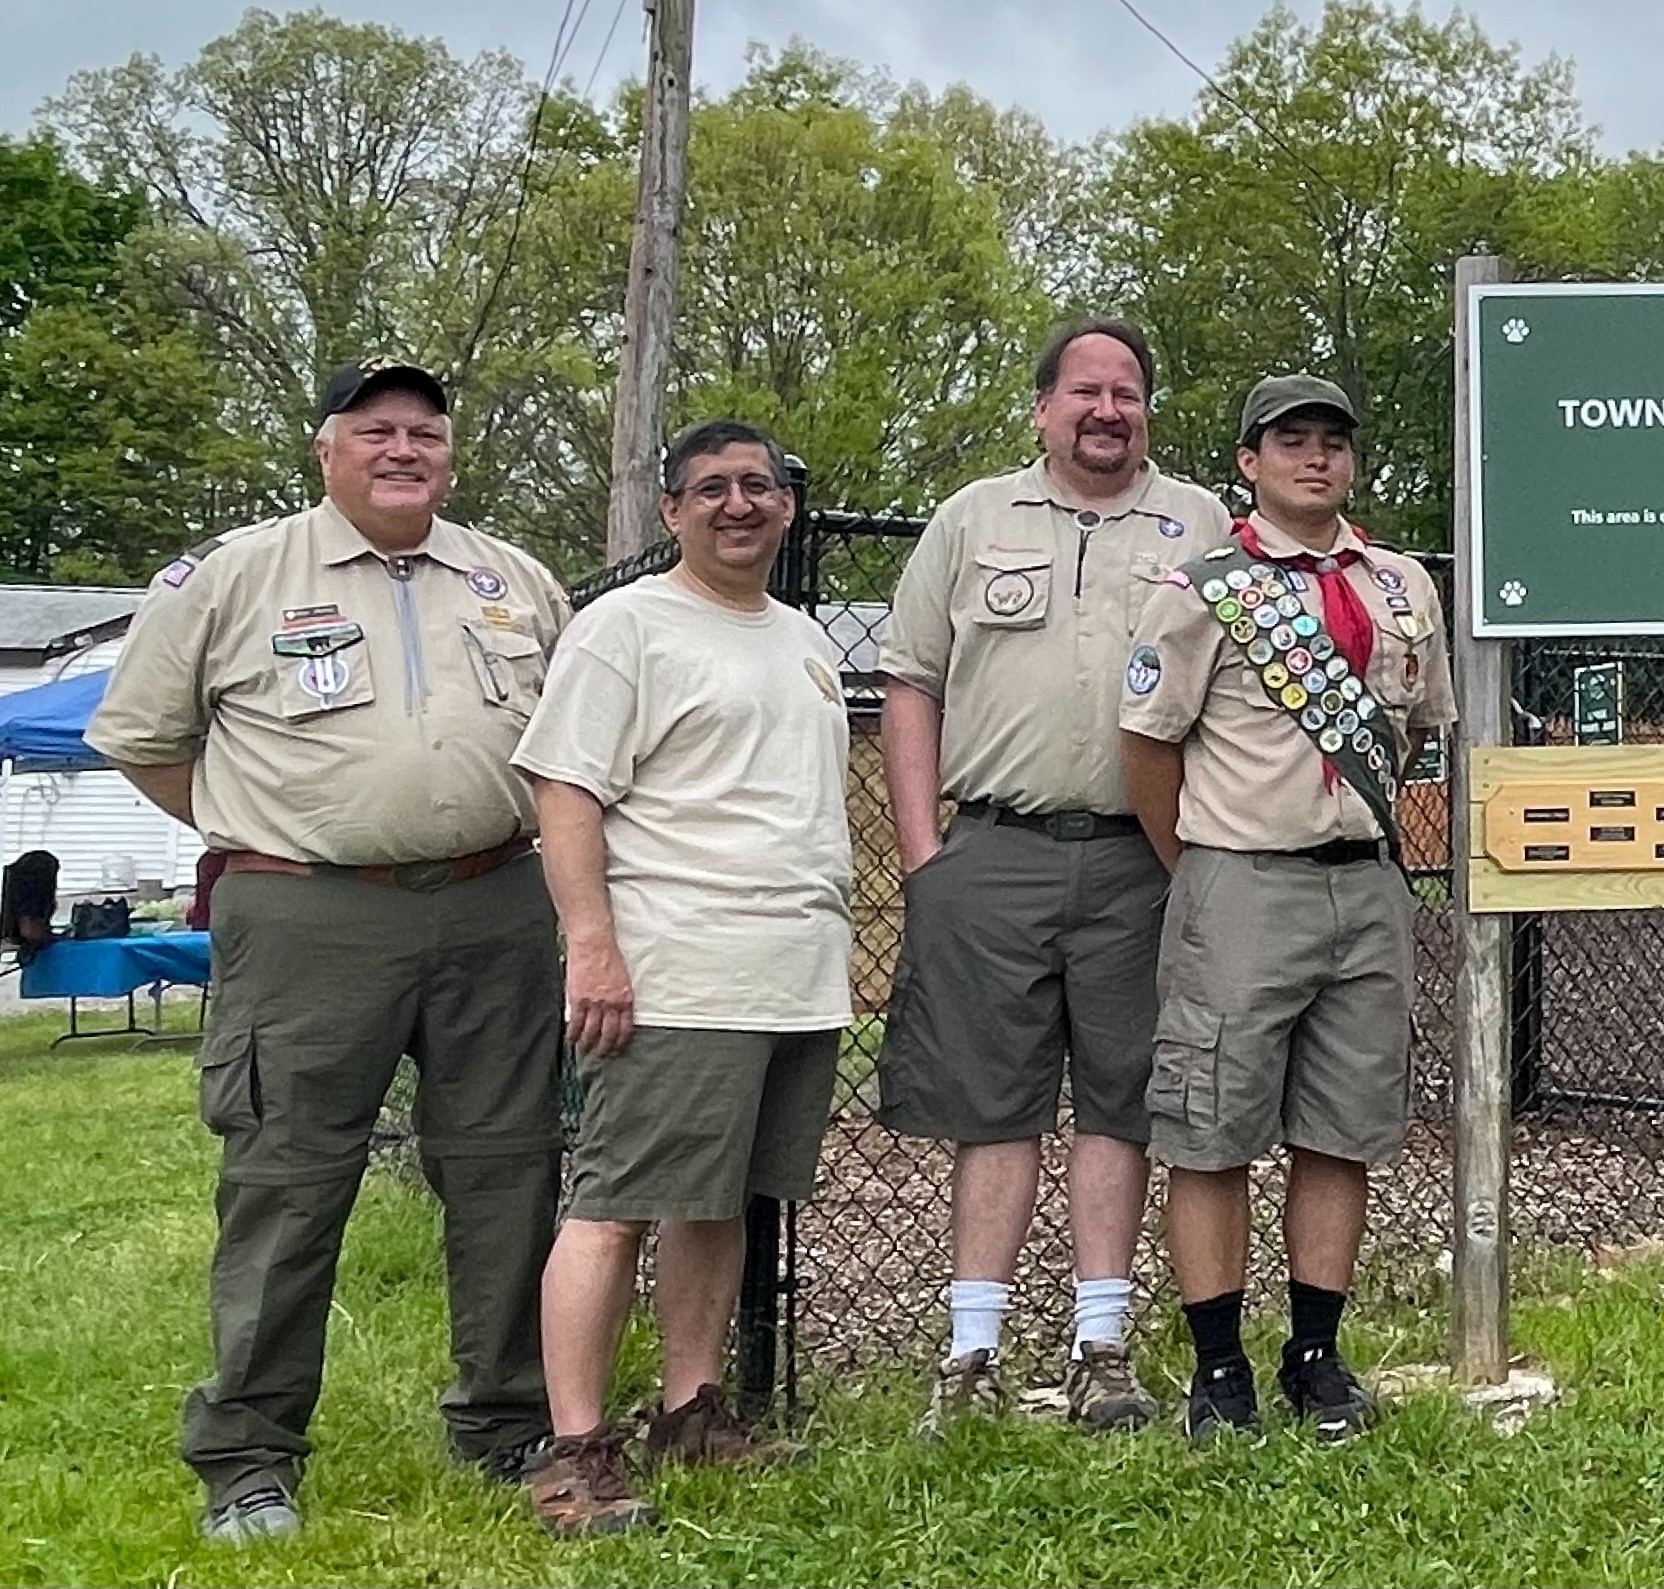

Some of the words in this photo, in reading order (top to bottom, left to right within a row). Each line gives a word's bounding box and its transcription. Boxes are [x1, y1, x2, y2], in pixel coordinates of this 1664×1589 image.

[1571, 509, 1604, 525] This
[1605, 510, 1641, 524] area
[1643, 507, 1657, 524] is
